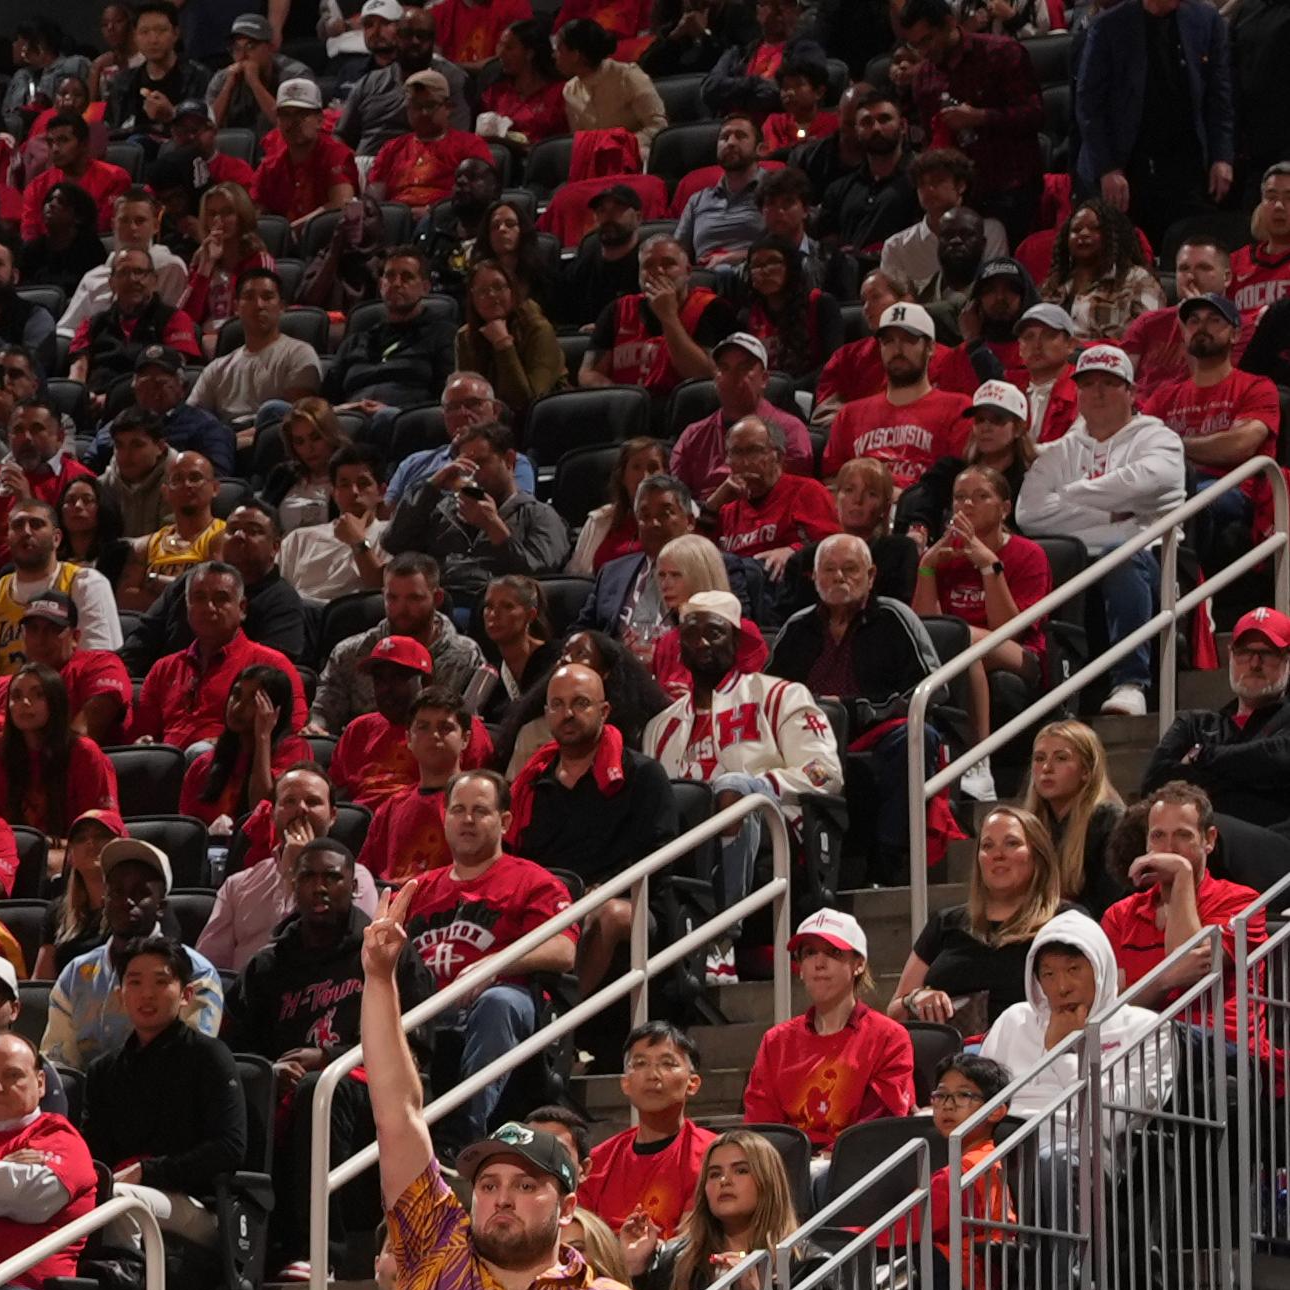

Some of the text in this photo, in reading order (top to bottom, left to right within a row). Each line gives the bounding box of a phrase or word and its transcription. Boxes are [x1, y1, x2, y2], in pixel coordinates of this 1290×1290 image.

[1235, 279, 1290, 310] ROCKE
[853, 424, 934, 458] WISCONSIN
[715, 703, 761, 751] H
[240, 1213, 248, 1238] 6
